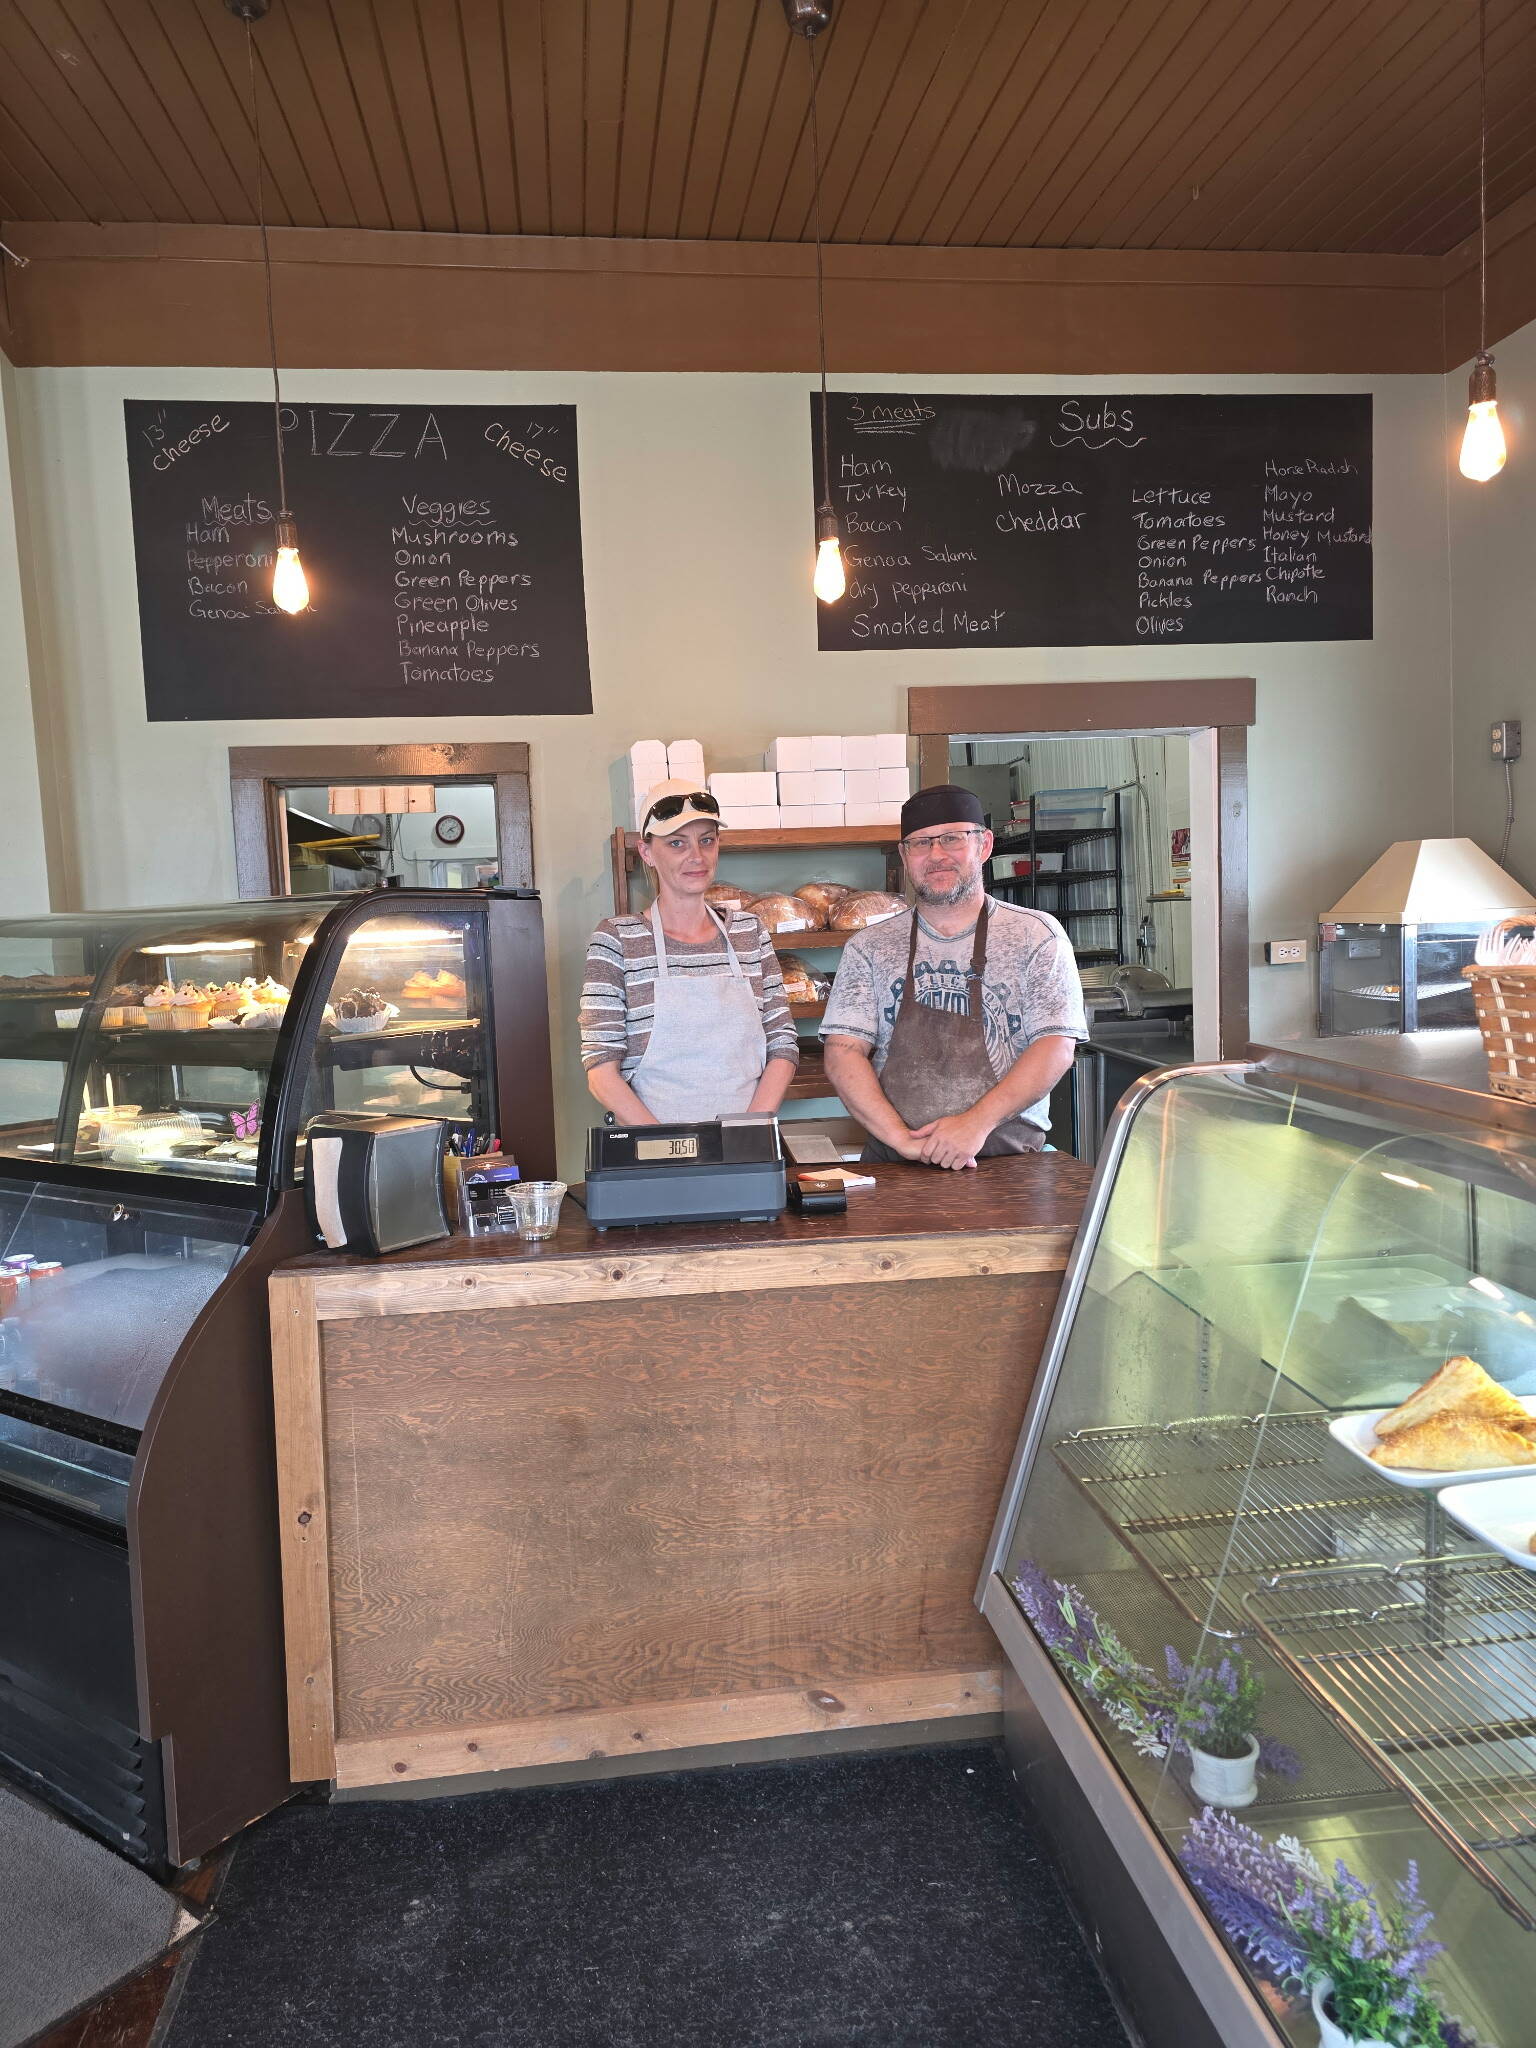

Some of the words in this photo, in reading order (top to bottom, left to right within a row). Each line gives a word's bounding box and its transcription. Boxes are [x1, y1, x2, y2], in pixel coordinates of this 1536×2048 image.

[847, 396, 865, 421] 3
[1058, 400, 1133, 431] Subs
[278, 408, 448, 460] PIZZA
[484, 423, 567, 483] Cheese
[841, 453, 892, 478] Ham
[998, 473, 1083, 496] Mozza
[201, 493, 273, 522] Meats
[402, 493, 491, 523] Veggies
[839, 483, 907, 512] Turkey
[1132, 488, 1211, 505] Lettuce
[1264, 484, 1313, 509] Mayo
[845, 511, 902, 534] Bacon
[1131, 511, 1226, 530] Tomatoes
[1263, 507, 1335, 524] Mustard
[186, 522, 231, 545] Ham
[391, 525, 519, 547] Mushrooms
[1137, 534, 1187, 551] Green
[1192, 534, 1257, 555] Peppers
[1263, 525, 1310, 548] Honey
[186, 551, 273, 575] Pepperoni
[394, 549, 451, 566] Onion
[844, 544, 912, 568] Genoa
[921, 544, 977, 563] Salami
[1138, 556, 1187, 569] Onion
[1263, 545, 1317, 564] Italian
[395, 570, 451, 588] Green
[458, 568, 533, 595] Peppers
[1138, 571, 1193, 589] Banana
[1202, 568, 1262, 591] Peppers
[1265, 563, 1326, 583] Chipotle
[187, 576, 249, 596] Bacon
[1265, 584, 1318, 604] Ranch
[189, 599, 251, 620] Genoa
[394, 591, 459, 612] Green
[465, 593, 519, 613] Olives
[1139, 591, 1193, 609] Pickles
[396, 612, 491, 642] Pineapple
[851, 608, 945, 638] Smoked
[953, 608, 1006, 634] Meat
[1135, 615, 1184, 635] Olives
[399, 640, 459, 658] Banana
[466, 639, 541, 666] Peppers
[400, 660, 495, 686] Tomatoes
